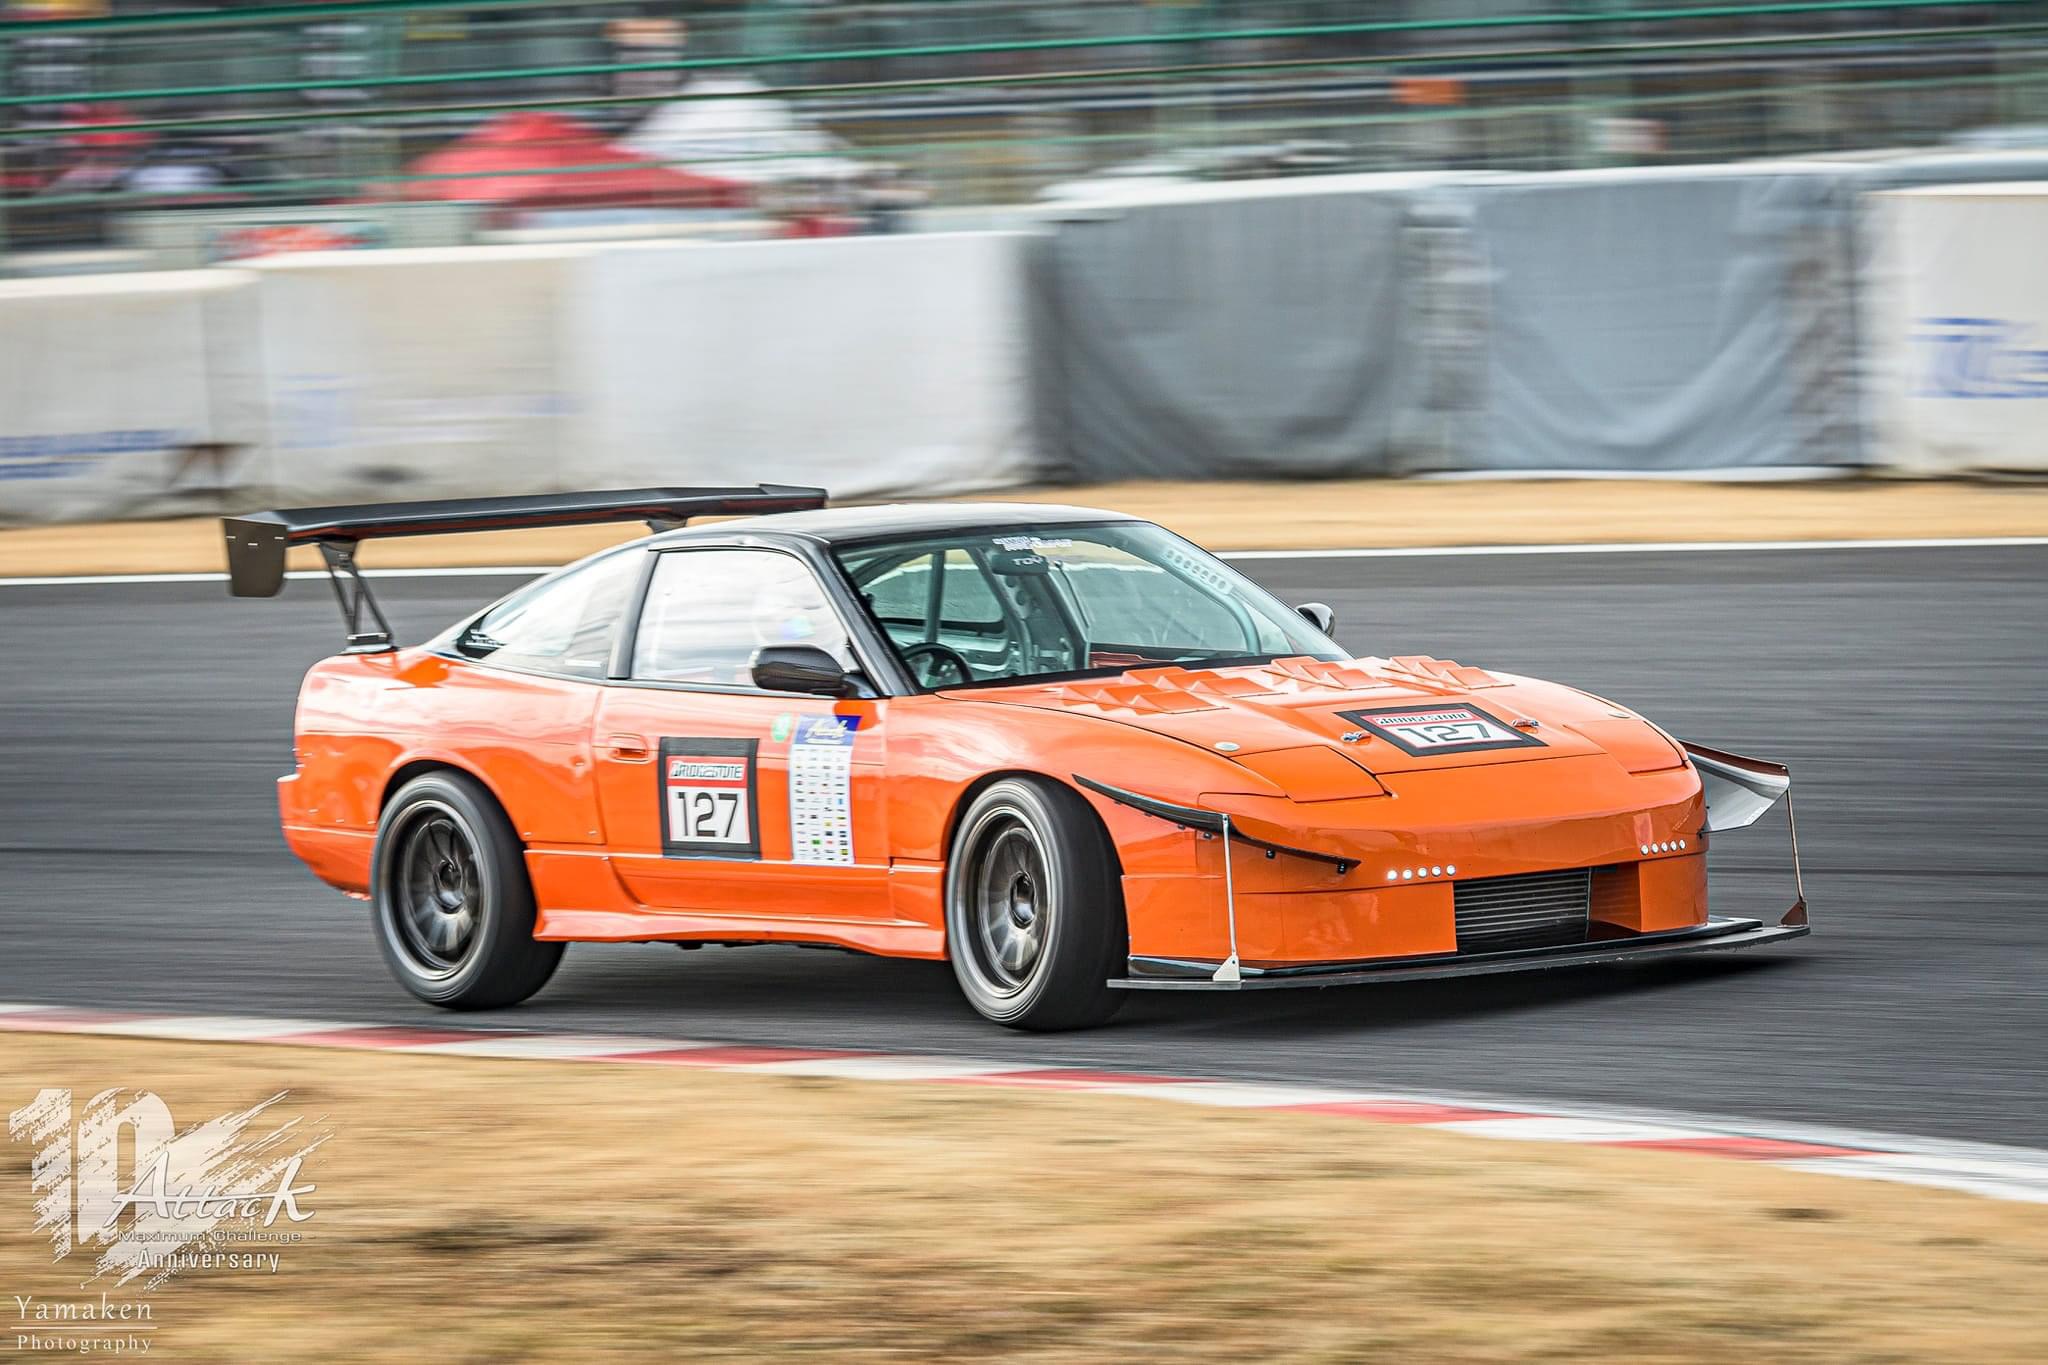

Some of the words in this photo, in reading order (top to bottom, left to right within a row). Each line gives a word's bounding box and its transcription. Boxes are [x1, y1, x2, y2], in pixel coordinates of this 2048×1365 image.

[1397, 722, 1491, 743] 127
[670, 760, 744, 779] BRIDGESTONE
[678, 791, 738, 837] 127
